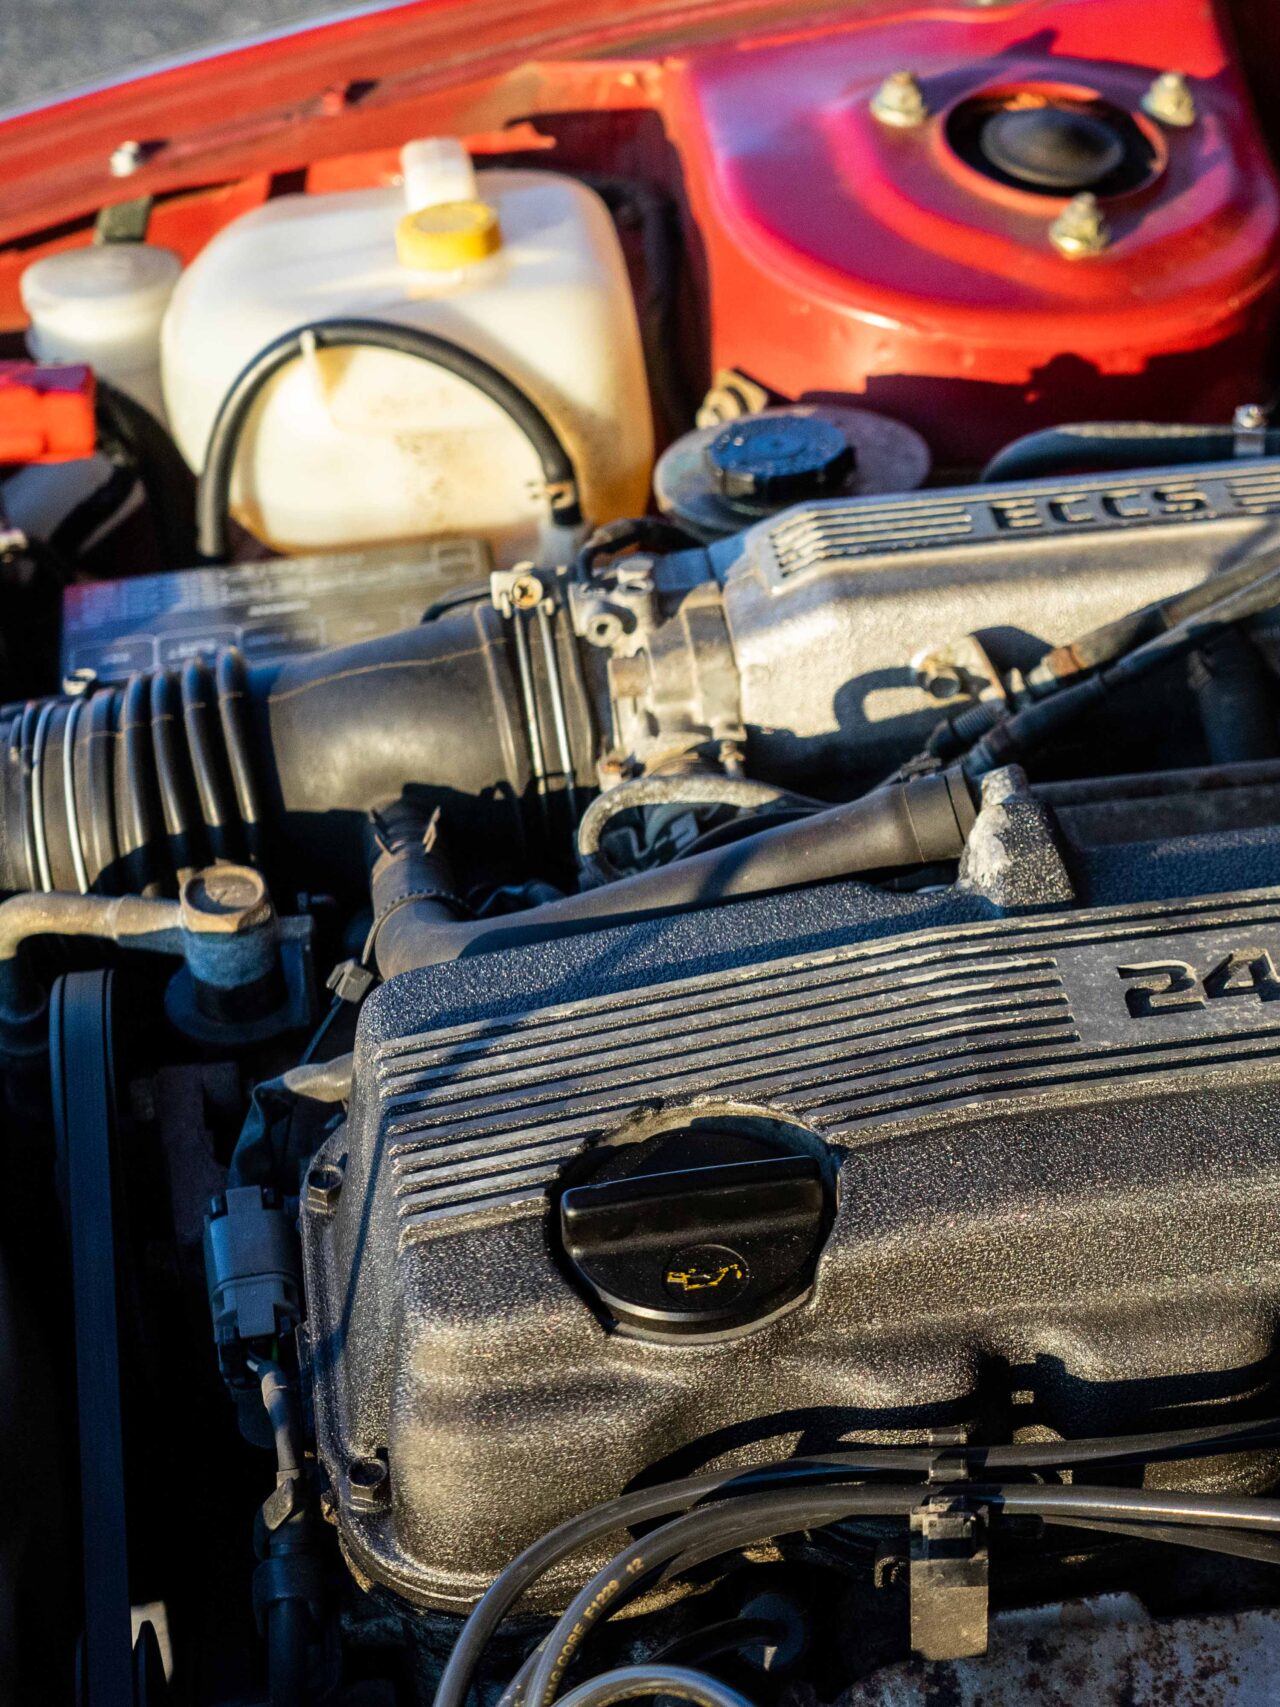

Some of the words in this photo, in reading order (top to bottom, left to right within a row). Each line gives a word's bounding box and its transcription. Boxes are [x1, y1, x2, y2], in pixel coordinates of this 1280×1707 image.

[990, 483, 1207, 529] ECCS
[557, 1622, 585, 1666] CORE
[626, 1557, 645, 1575] 12
